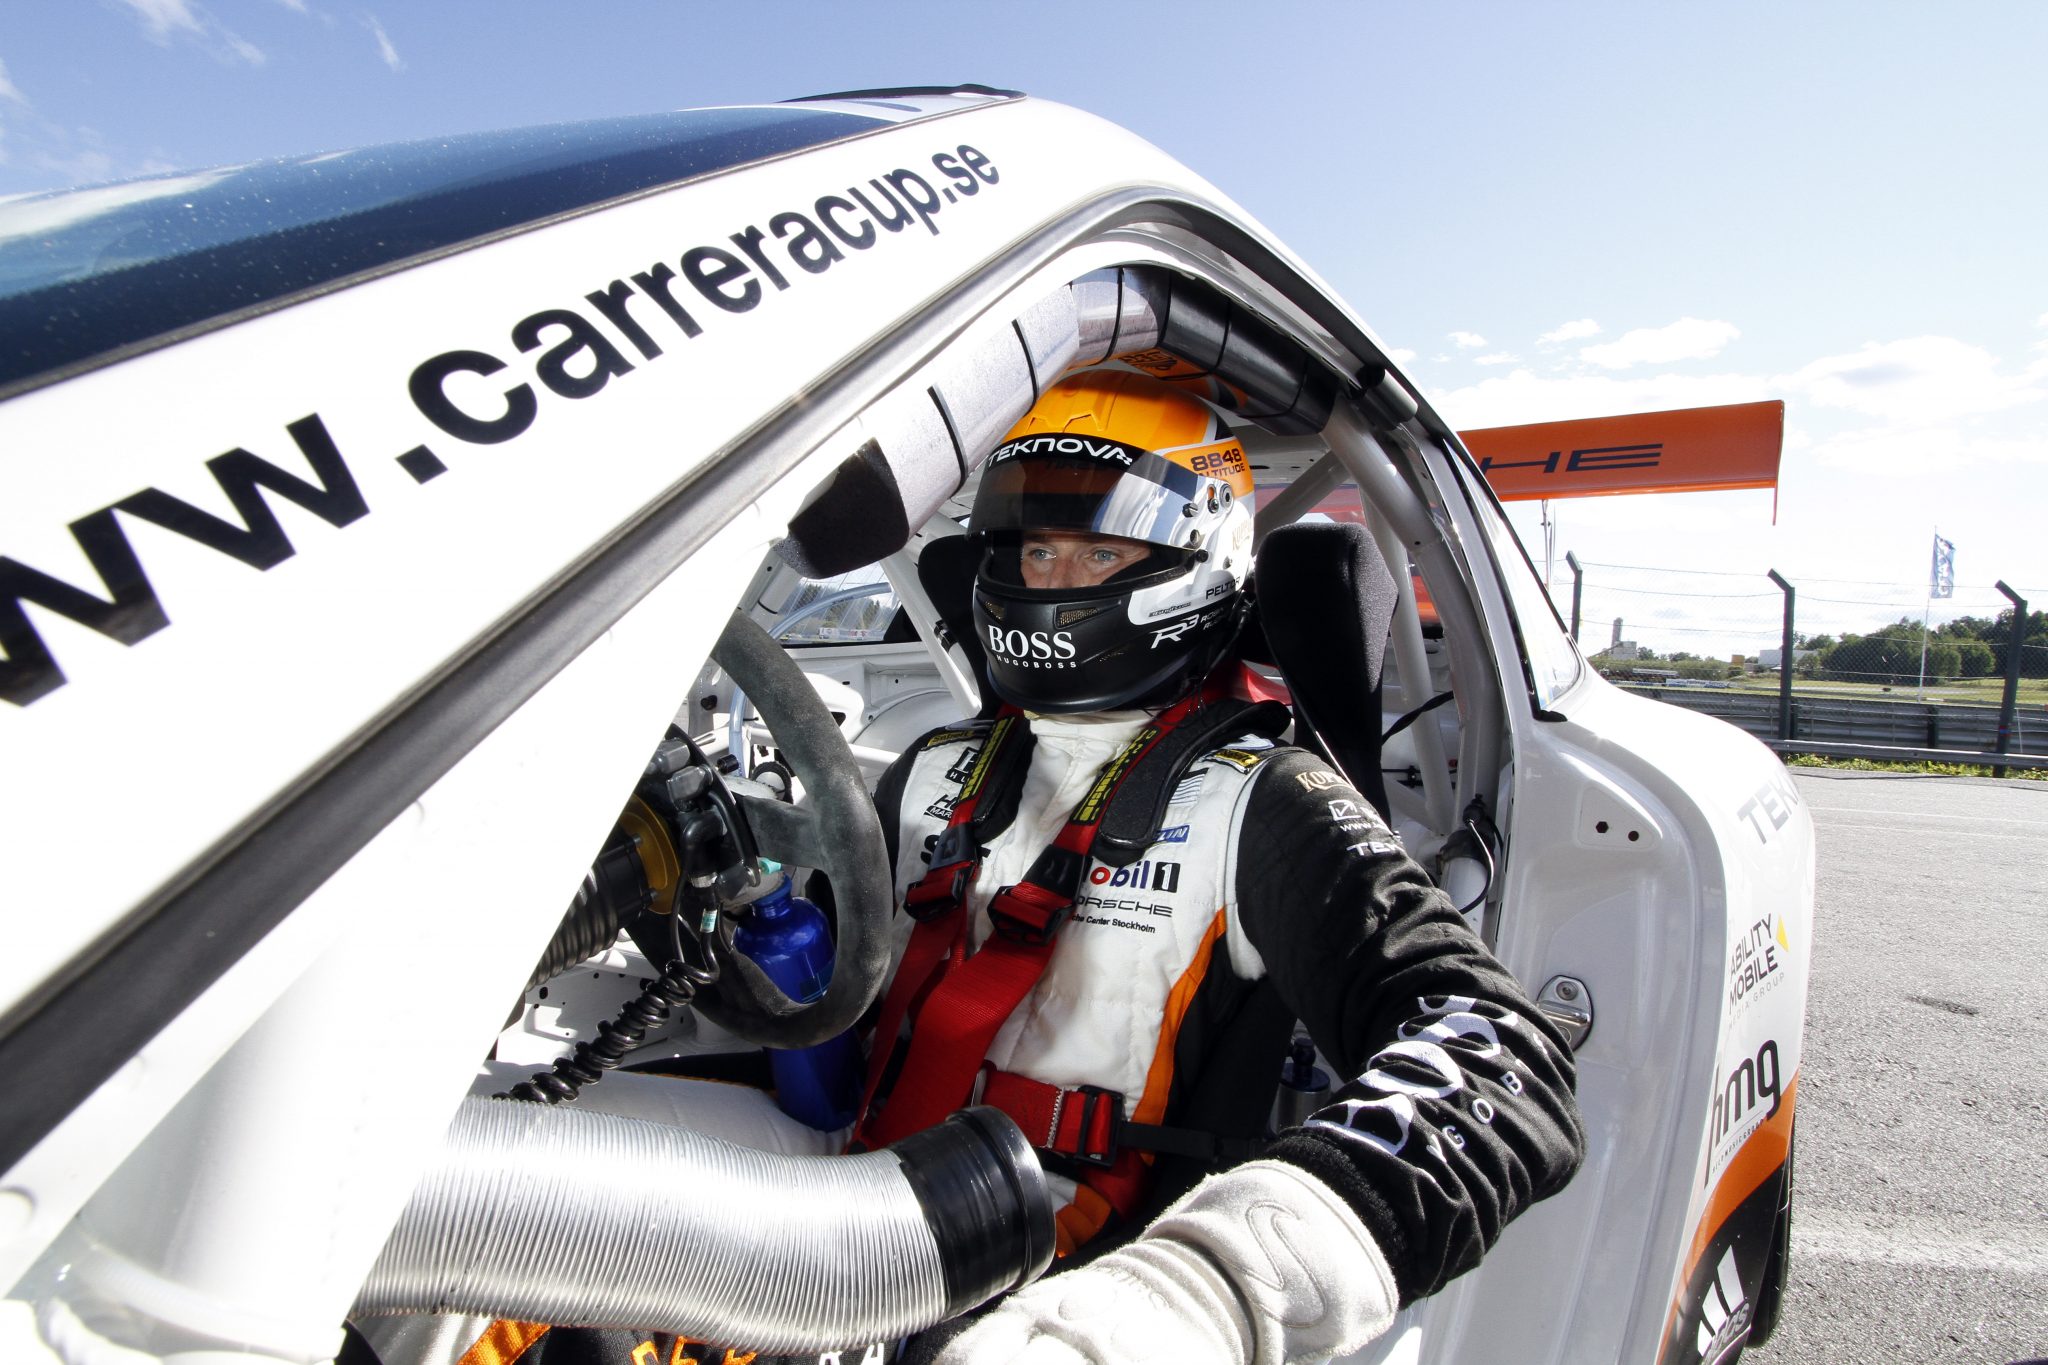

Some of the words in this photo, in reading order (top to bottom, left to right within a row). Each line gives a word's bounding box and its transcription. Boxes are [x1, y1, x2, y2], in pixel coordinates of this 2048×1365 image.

[987, 437, 1133, 468] TEKNOVA
[1190, 448, 1242, 471] 8848
[988, 624, 1077, 660] BOSS
[1077, 895, 1174, 918] ORSCHE
[1086, 915, 1111, 926] Center
[1112, 918, 1156, 934] Stockholm
[1729, 912, 1773, 978] ABILITY
[1728, 945, 1779, 1015] MOBILE
[1753, 972, 1786, 1003] GROUP
[1703, 1038, 1782, 1190] hmg
